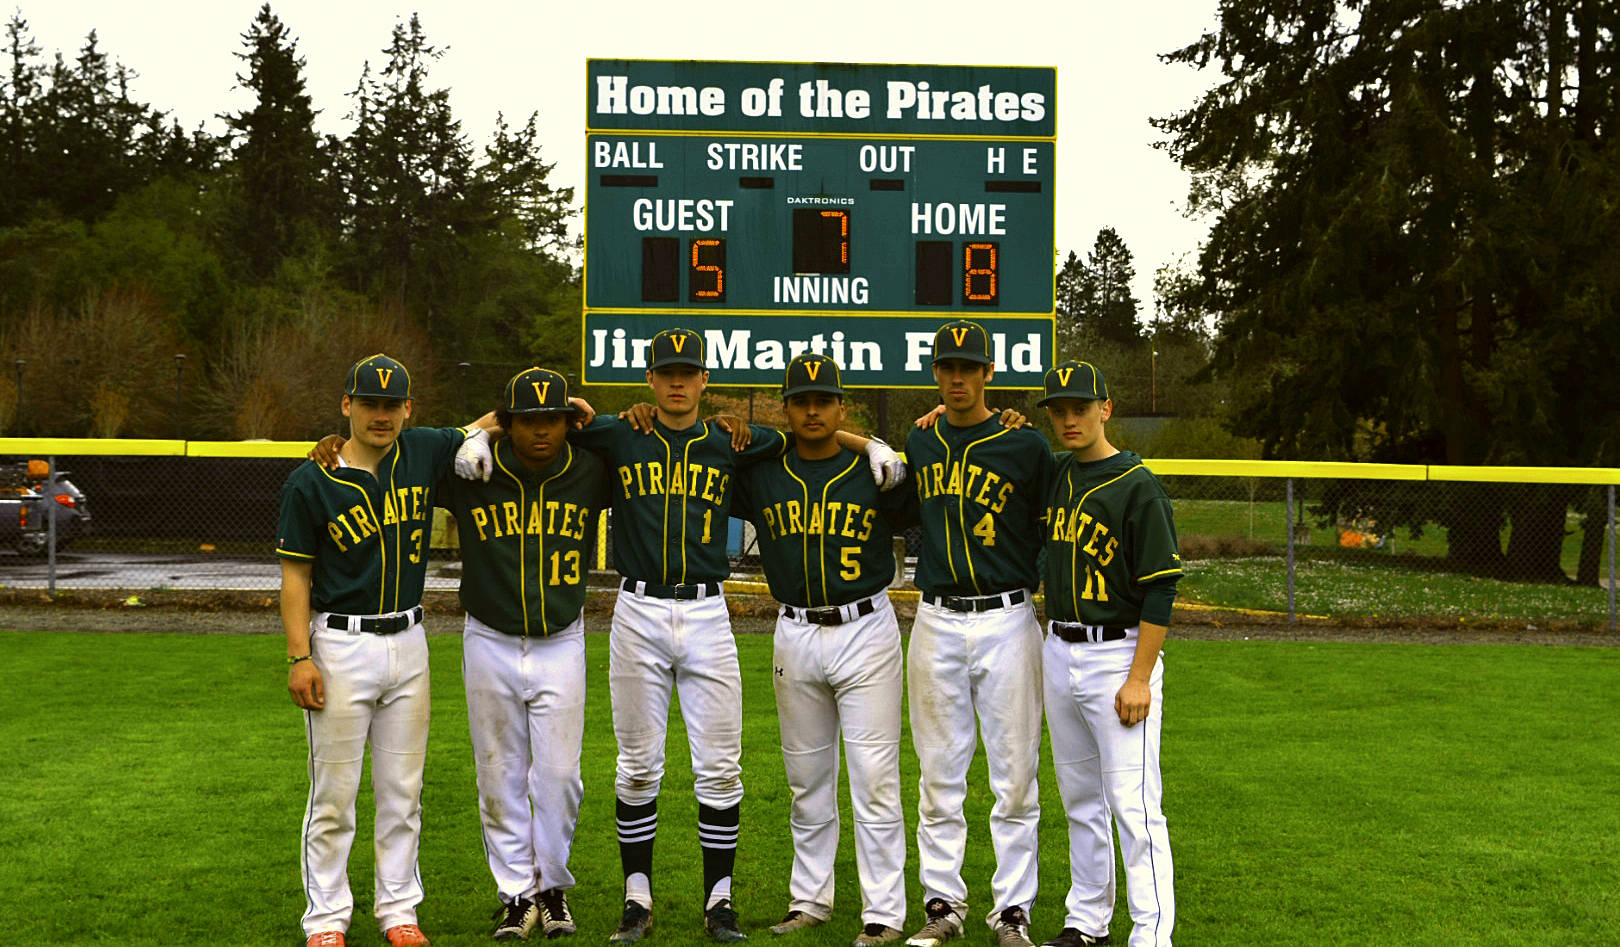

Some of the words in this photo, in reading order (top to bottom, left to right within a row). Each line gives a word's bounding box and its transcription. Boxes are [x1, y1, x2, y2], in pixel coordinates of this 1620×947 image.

[596, 75, 725, 116] Home
[741, 78, 785, 117] of
[798, 79, 871, 119] the
[886, 81, 1046, 122] Pirates
[594, 141, 664, 169] BALL
[707, 142, 803, 171] STRIKE
[859, 144, 916, 173] OUT
[987, 147, 1005, 174] H
[1023, 148, 1038, 175] E
[633, 198, 734, 232] GUEST
[786, 196, 855, 206] DAKTRONICS
[911, 202, 1006, 235] HOME
[820, 211, 847, 264] 7
[692, 239, 723, 297] 5
[965, 243, 996, 300] 8
[773, 276, 869, 305] INNING
[670, 334, 688, 354] V
[704, 329, 883, 372] Martin
[904, 332, 1043, 373] Fld
[951, 327, 969, 347] V
[376, 368, 393, 390] V
[803, 361, 822, 381] V
[1056, 367, 1074, 387] V
[532, 381, 550, 404] V
[618, 461, 730, 506] PIRATES
[471, 501, 589, 541] PIRATES
[701, 509, 712, 544] 1
[762, 500, 877, 542] PIRATES
[972, 512, 996, 546] 4
[1046, 507, 1119, 567] RATES
[408, 528, 423, 565] 3
[839, 546, 862, 581] 5
[549, 550, 581, 586] 13
[1081, 564, 1109, 602] 11
